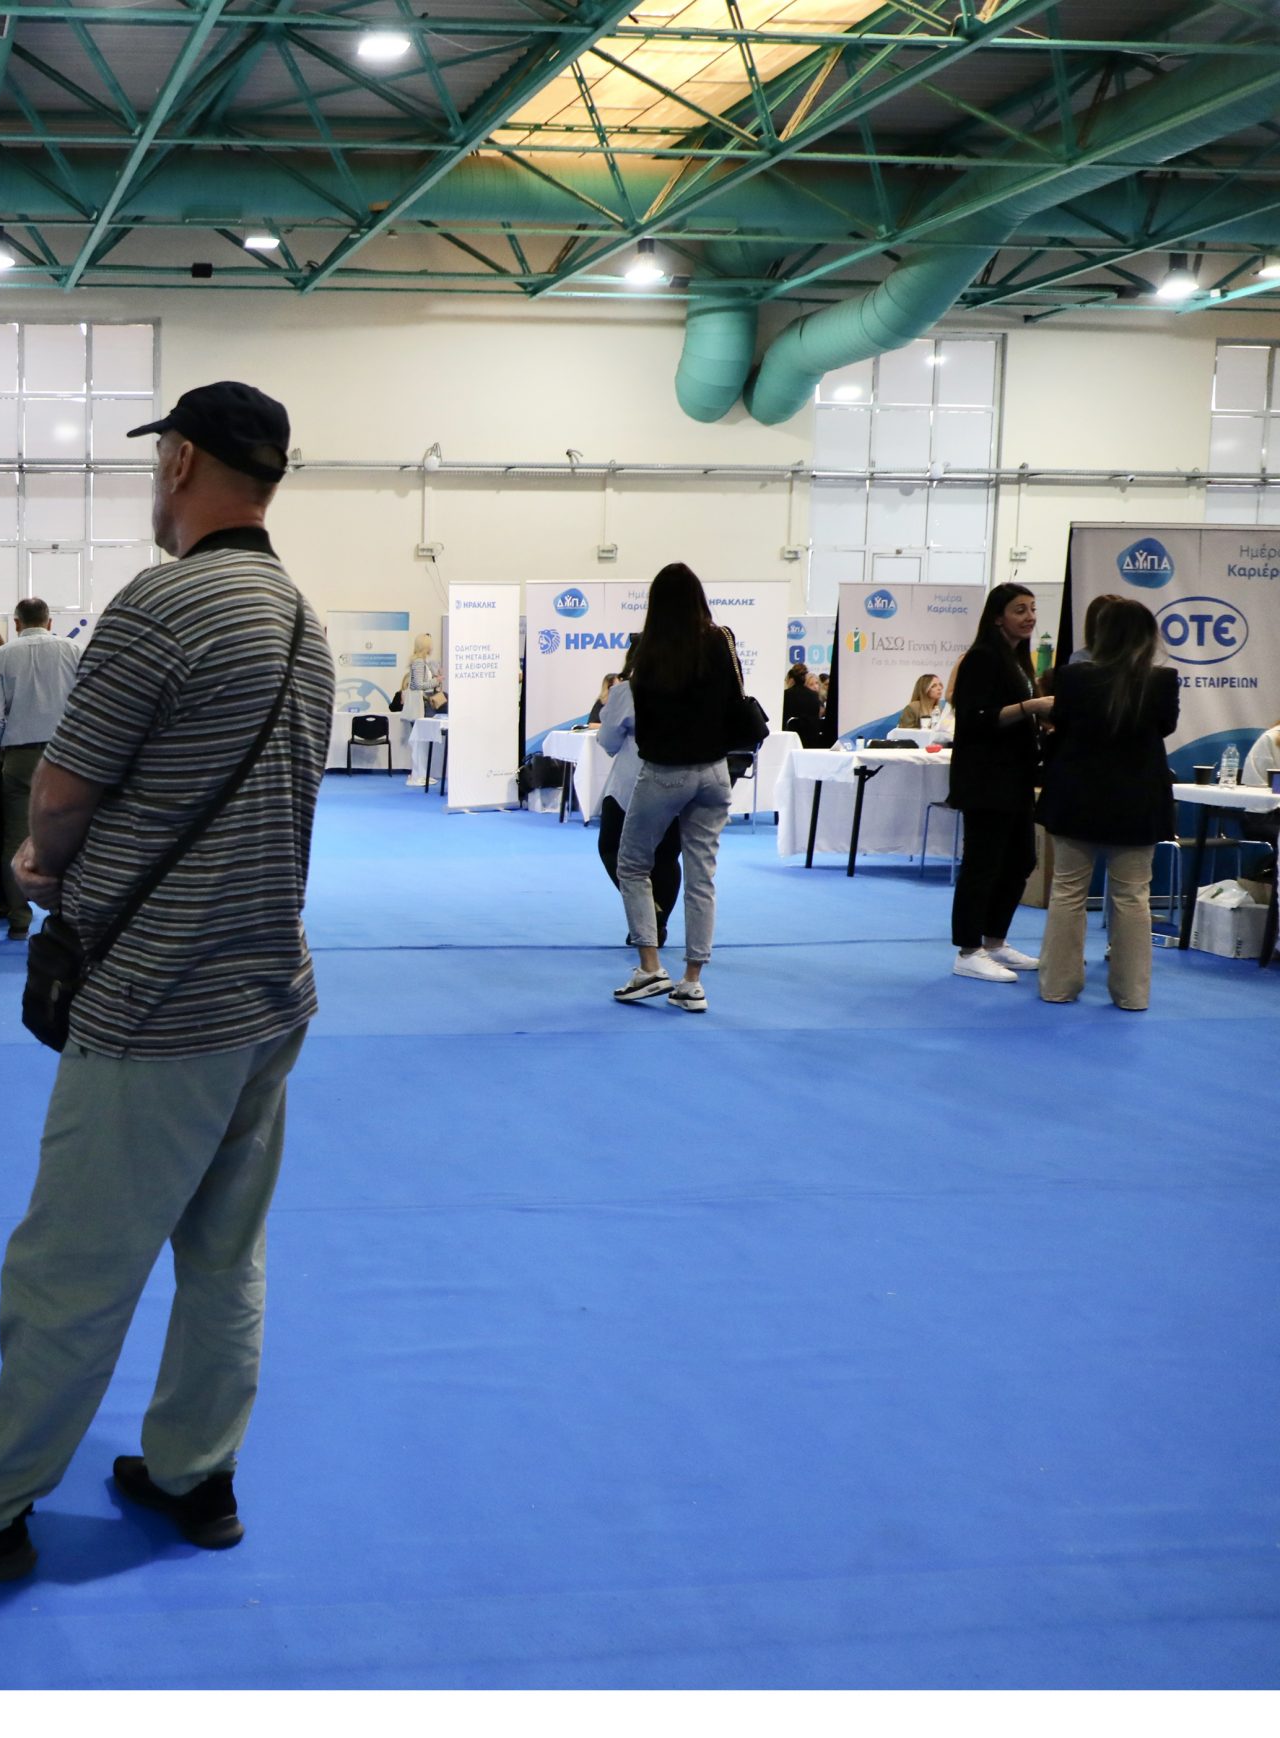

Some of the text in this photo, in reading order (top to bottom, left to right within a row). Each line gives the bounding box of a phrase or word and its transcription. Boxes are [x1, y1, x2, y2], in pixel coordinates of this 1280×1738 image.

[1239, 543, 1280, 560] Ημέρ
[1228, 563, 1280, 580] Καριέρ
[463, 601, 496, 609] ΗΡΑΚΛΗΣ
[621, 601, 649, 611] Καριέ
[708, 598, 755, 606] ΗΡΑΚΛΗΣ
[927, 604, 968, 615] Καριέρας
[455, 644, 490, 652] ΟΔΗΓΟΥΜΕ
[908, 640, 938, 654] Γενική
[940, 640, 972, 652] Κλινικ
[465, 653, 500, 661] ΜΕΤΑΒΑΣΗ
[465, 662, 498, 670] ΑΕΙΦΟΡΕΣ
[455, 671, 496, 679] ΚΑΤΑΣΚΕΥΕΣ
[1195, 676, 1258, 688] ΕΤΑΙΡΕΙΩΝ
